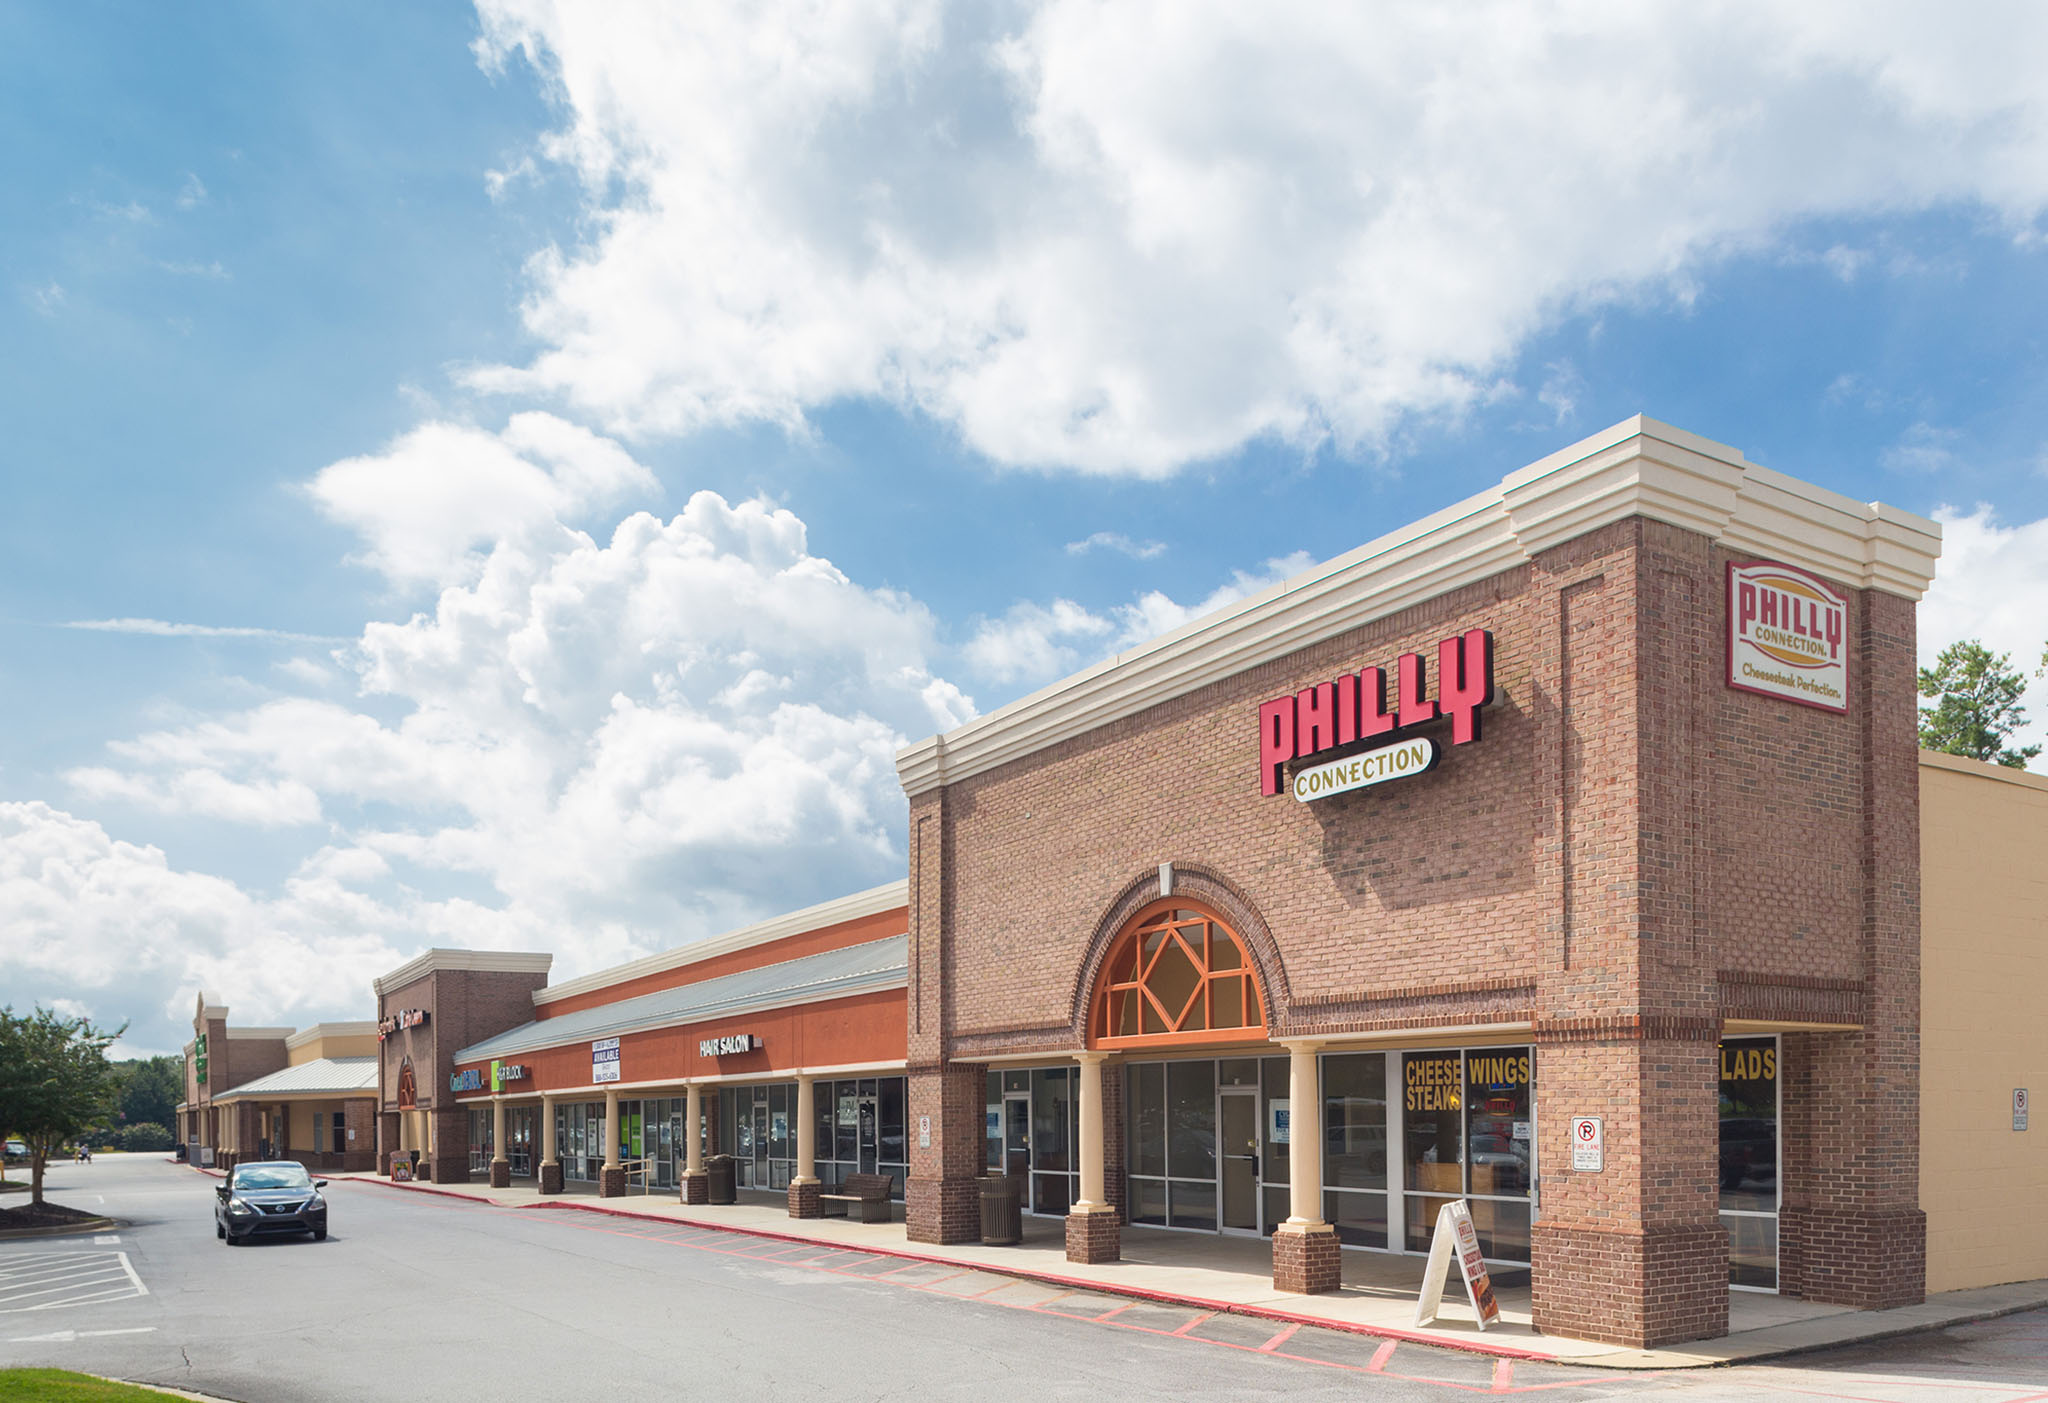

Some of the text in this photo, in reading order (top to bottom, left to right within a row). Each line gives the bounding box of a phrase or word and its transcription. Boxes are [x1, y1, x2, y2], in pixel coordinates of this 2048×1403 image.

[1739, 581, 1841, 659] PHILLY
[1755, 626, 1825, 656] CONNECTION
[1742, 662, 1796, 688] Cheesesteak
[1259, 628, 1490, 796] PHILLY
[1296, 744, 1424, 796] CONNECTION
[594, 1049, 619, 1062] AVAILABLE
[699, 1034, 749, 1057] HAIR SALON
[1406, 1059, 1461, 1085] CHEESE
[1469, 1057, 1529, 1084] WINGS
[1407, 1085, 1461, 1111] STEAKS
